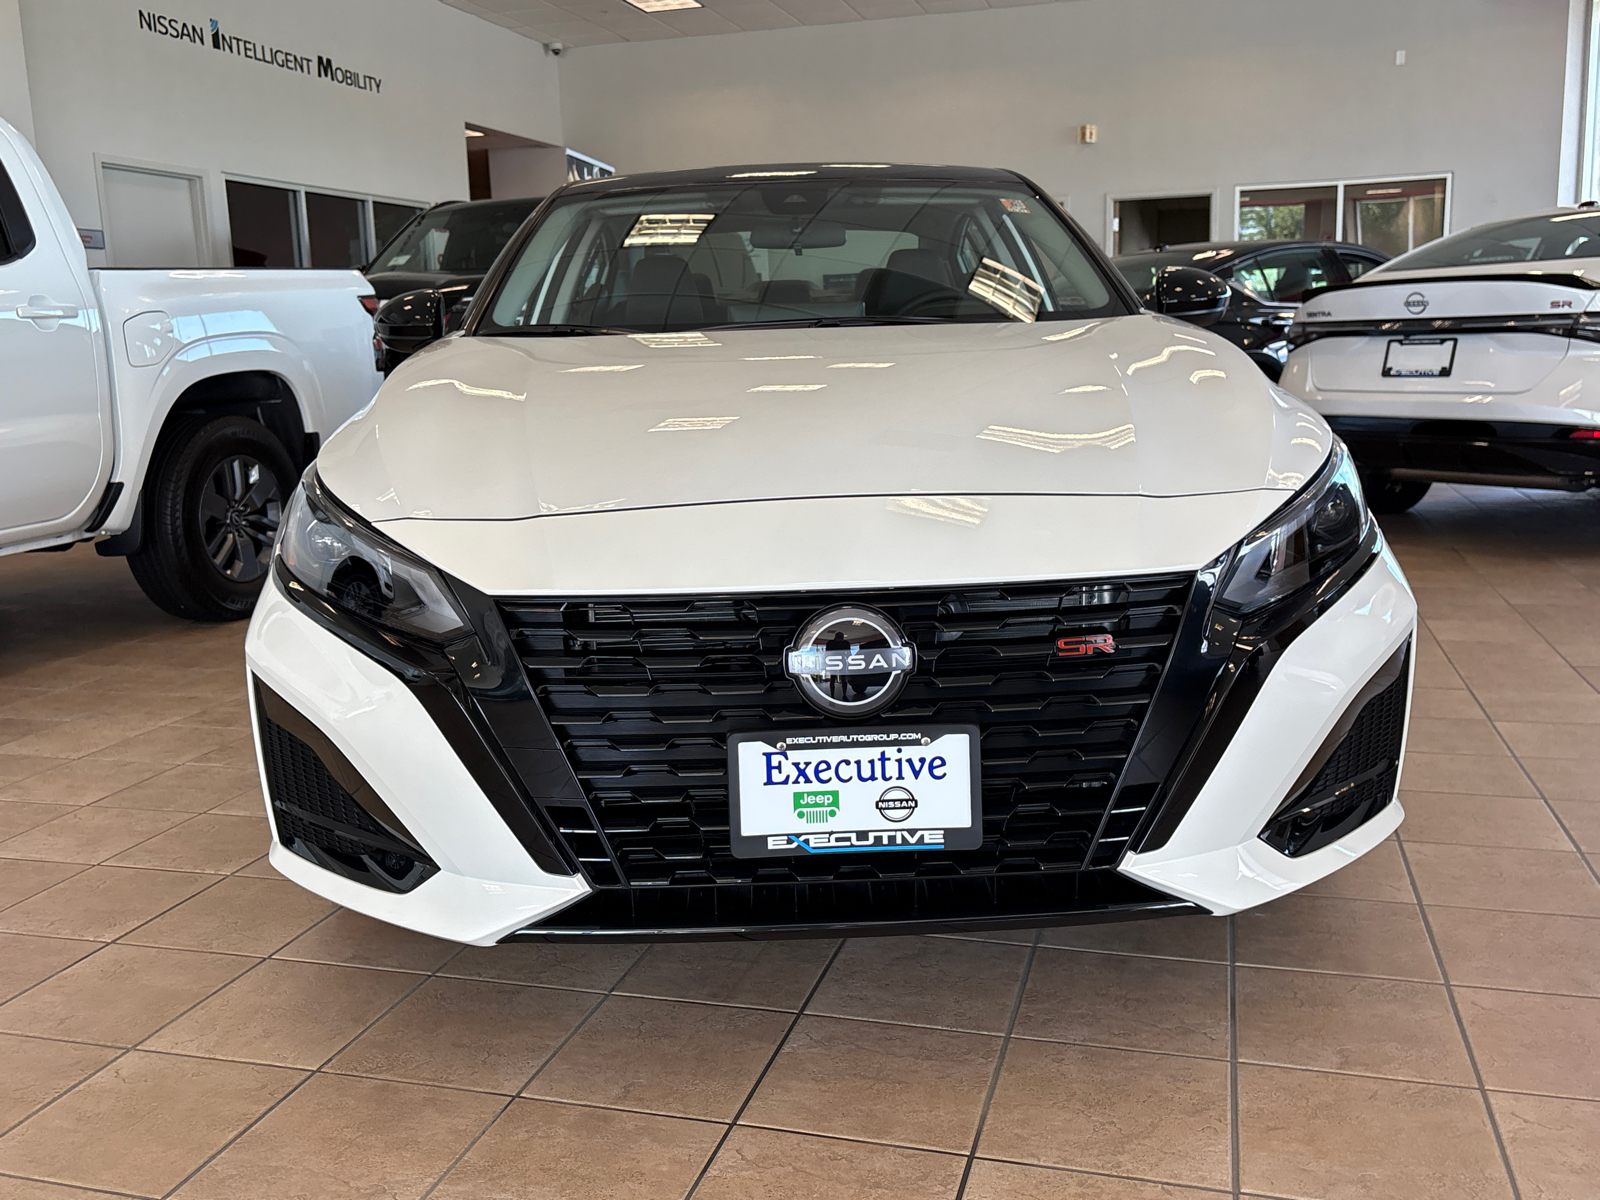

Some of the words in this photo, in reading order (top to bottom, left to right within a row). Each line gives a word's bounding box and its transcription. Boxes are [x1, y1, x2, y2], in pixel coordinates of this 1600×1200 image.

[138, 9, 205, 46] NISSAN
[209, 17, 313, 75] INTELLIGENT
[316, 55, 382, 94] MOBILITY
[1550, 300, 1572, 309] SR
[1057, 633, 1116, 656] SR
[786, 733, 922, 745] EXECUTIVEAUTOGROUP.COM
[762, 747, 948, 786] Executive
[800, 793, 833, 806] Jeep
[878, 800, 915, 809] NISSAN
[767, 830, 945, 852] EXECUTIVE
